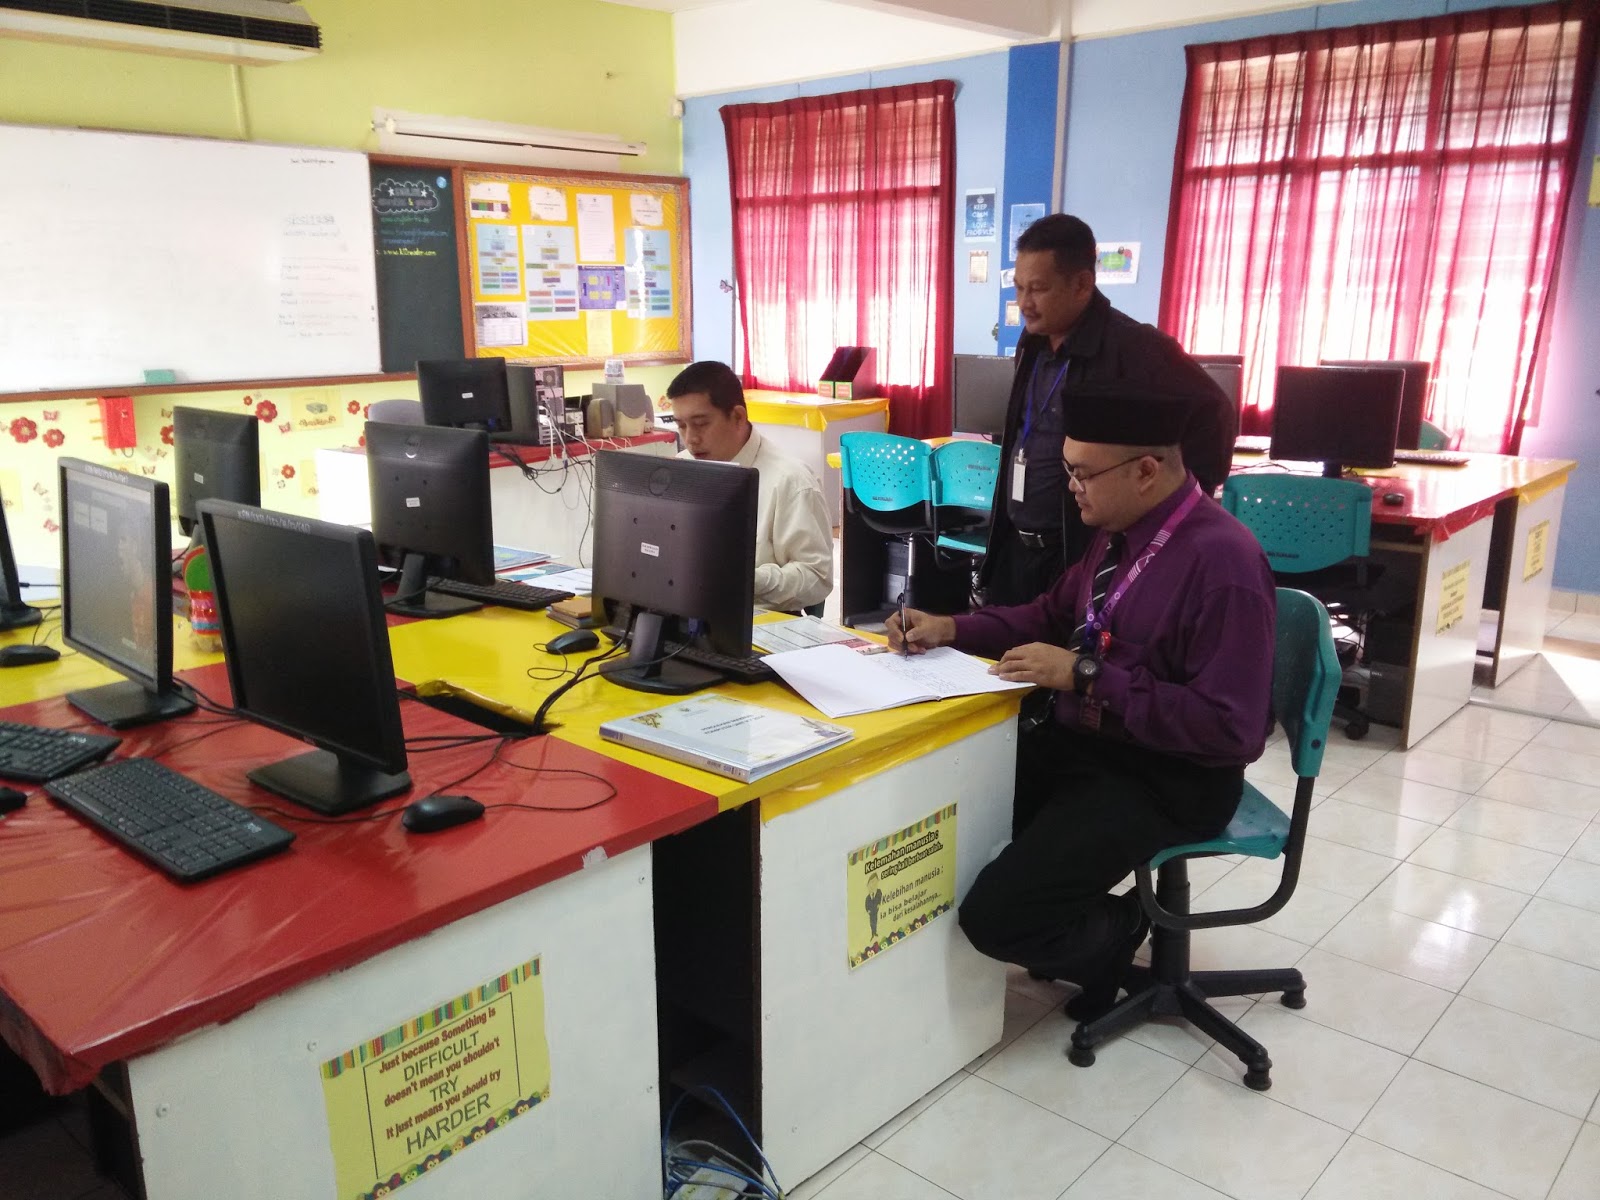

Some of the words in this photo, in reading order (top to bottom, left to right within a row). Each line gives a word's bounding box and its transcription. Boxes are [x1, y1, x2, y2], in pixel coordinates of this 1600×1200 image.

[972, 221, 987, 229] LOVE
[865, 847, 905, 874] Kelemahan
[905, 831, 935, 854] manusia
[881, 865, 898, 880] sering
[880, 911, 887, 920] ia
[888, 903, 902, 915] bisa
[903, 888, 928, 906] belajar
[881, 882, 914, 905] Kelebihan
[914, 867, 940, 887] manusia
[892, 911, 903, 922] dari
[379, 1055, 400, 1074] Just
[401, 1037, 440, 1062] because
[441, 1012, 487, 1042] Something
[488, 1007, 496, 1018] is
[403, 1031, 479, 1082] DIFFICULT
[384, 1081, 418, 1107] doesn't
[420, 1069, 444, 1088] mean
[445, 1061, 461, 1077] you
[463, 1036, 500, 1066] shouldn't
[429, 1075, 459, 1102] TRY
[386, 1127, 394, 1140] It
[395, 1117, 413, 1138] just
[414, 1102, 443, 1124] means
[445, 1093, 460, 1111] you
[462, 1074, 488, 1098] should
[489, 1069, 501, 1081] try
[406, 1093, 491, 1155] HARDER
